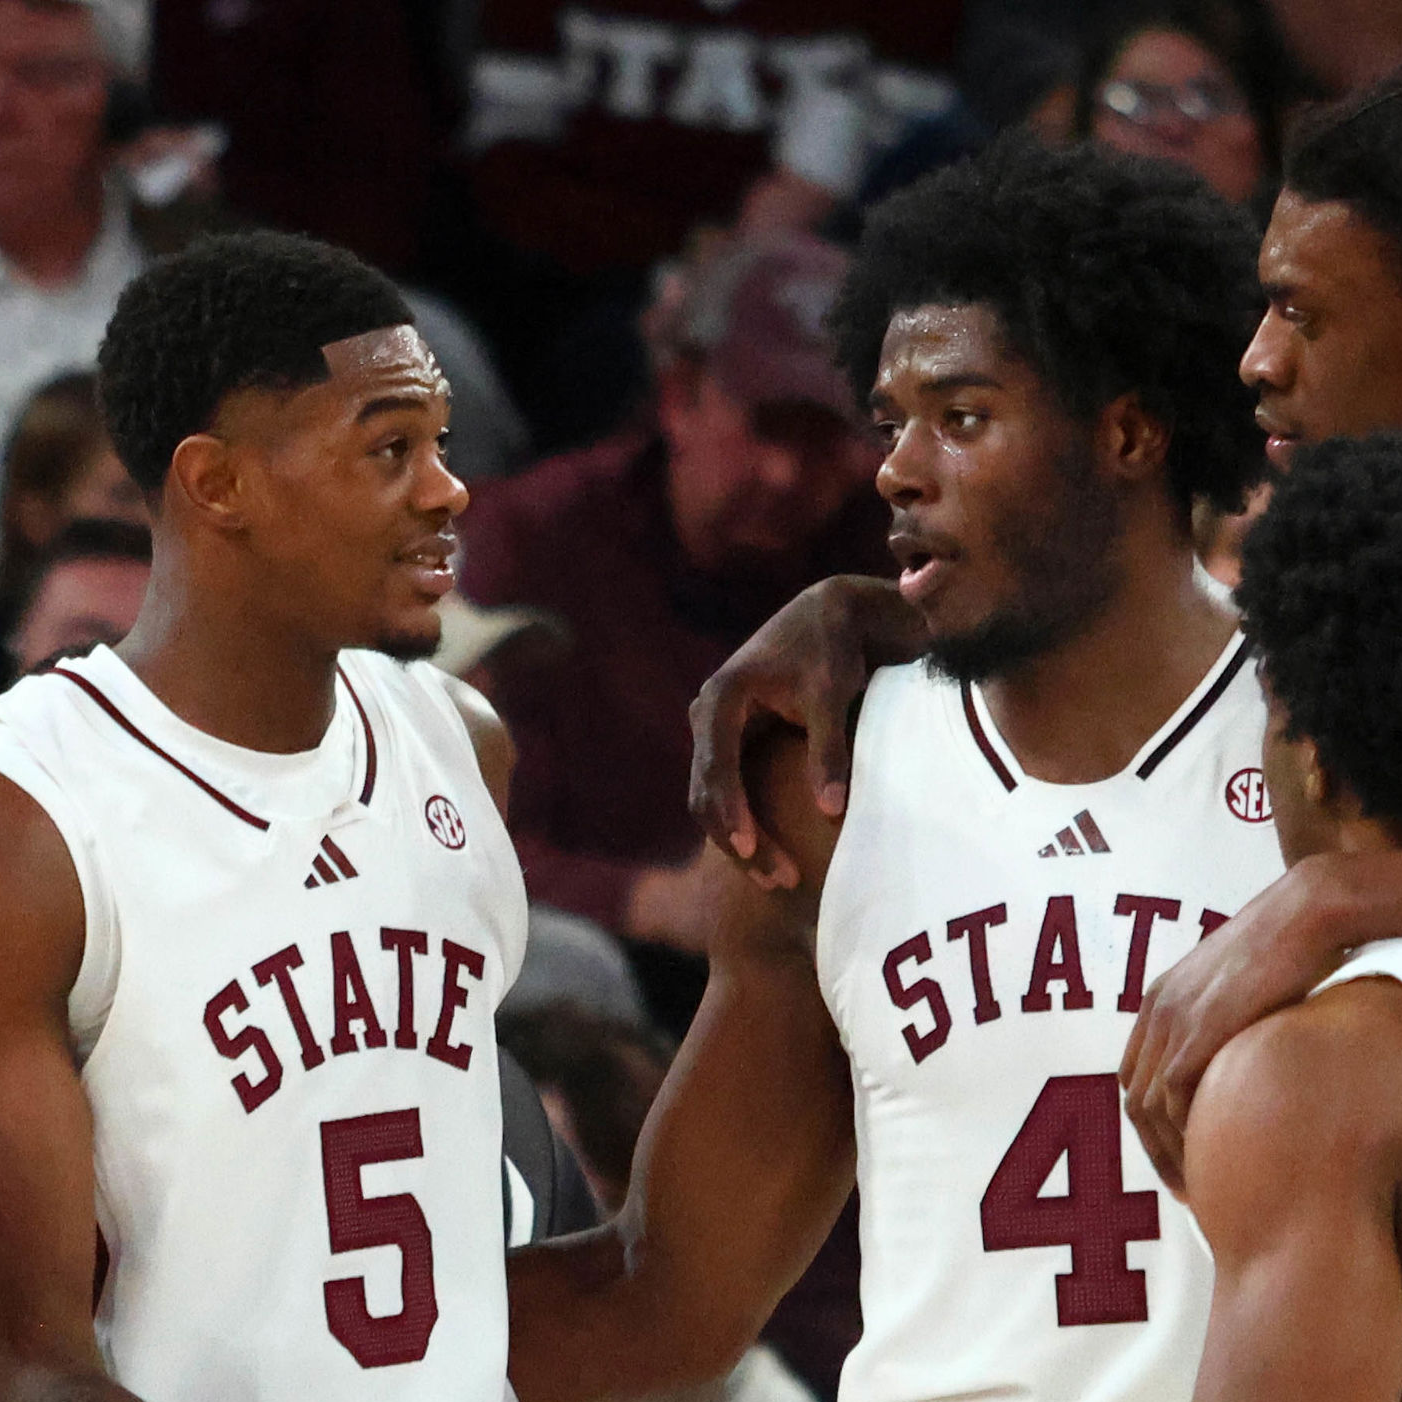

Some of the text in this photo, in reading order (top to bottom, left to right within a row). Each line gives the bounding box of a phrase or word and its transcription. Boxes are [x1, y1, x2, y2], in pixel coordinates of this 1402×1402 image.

[202, 927, 486, 1115] STATE
[319, 1107, 439, 1370] 5
[979, 1072, 1161, 1327] 4
